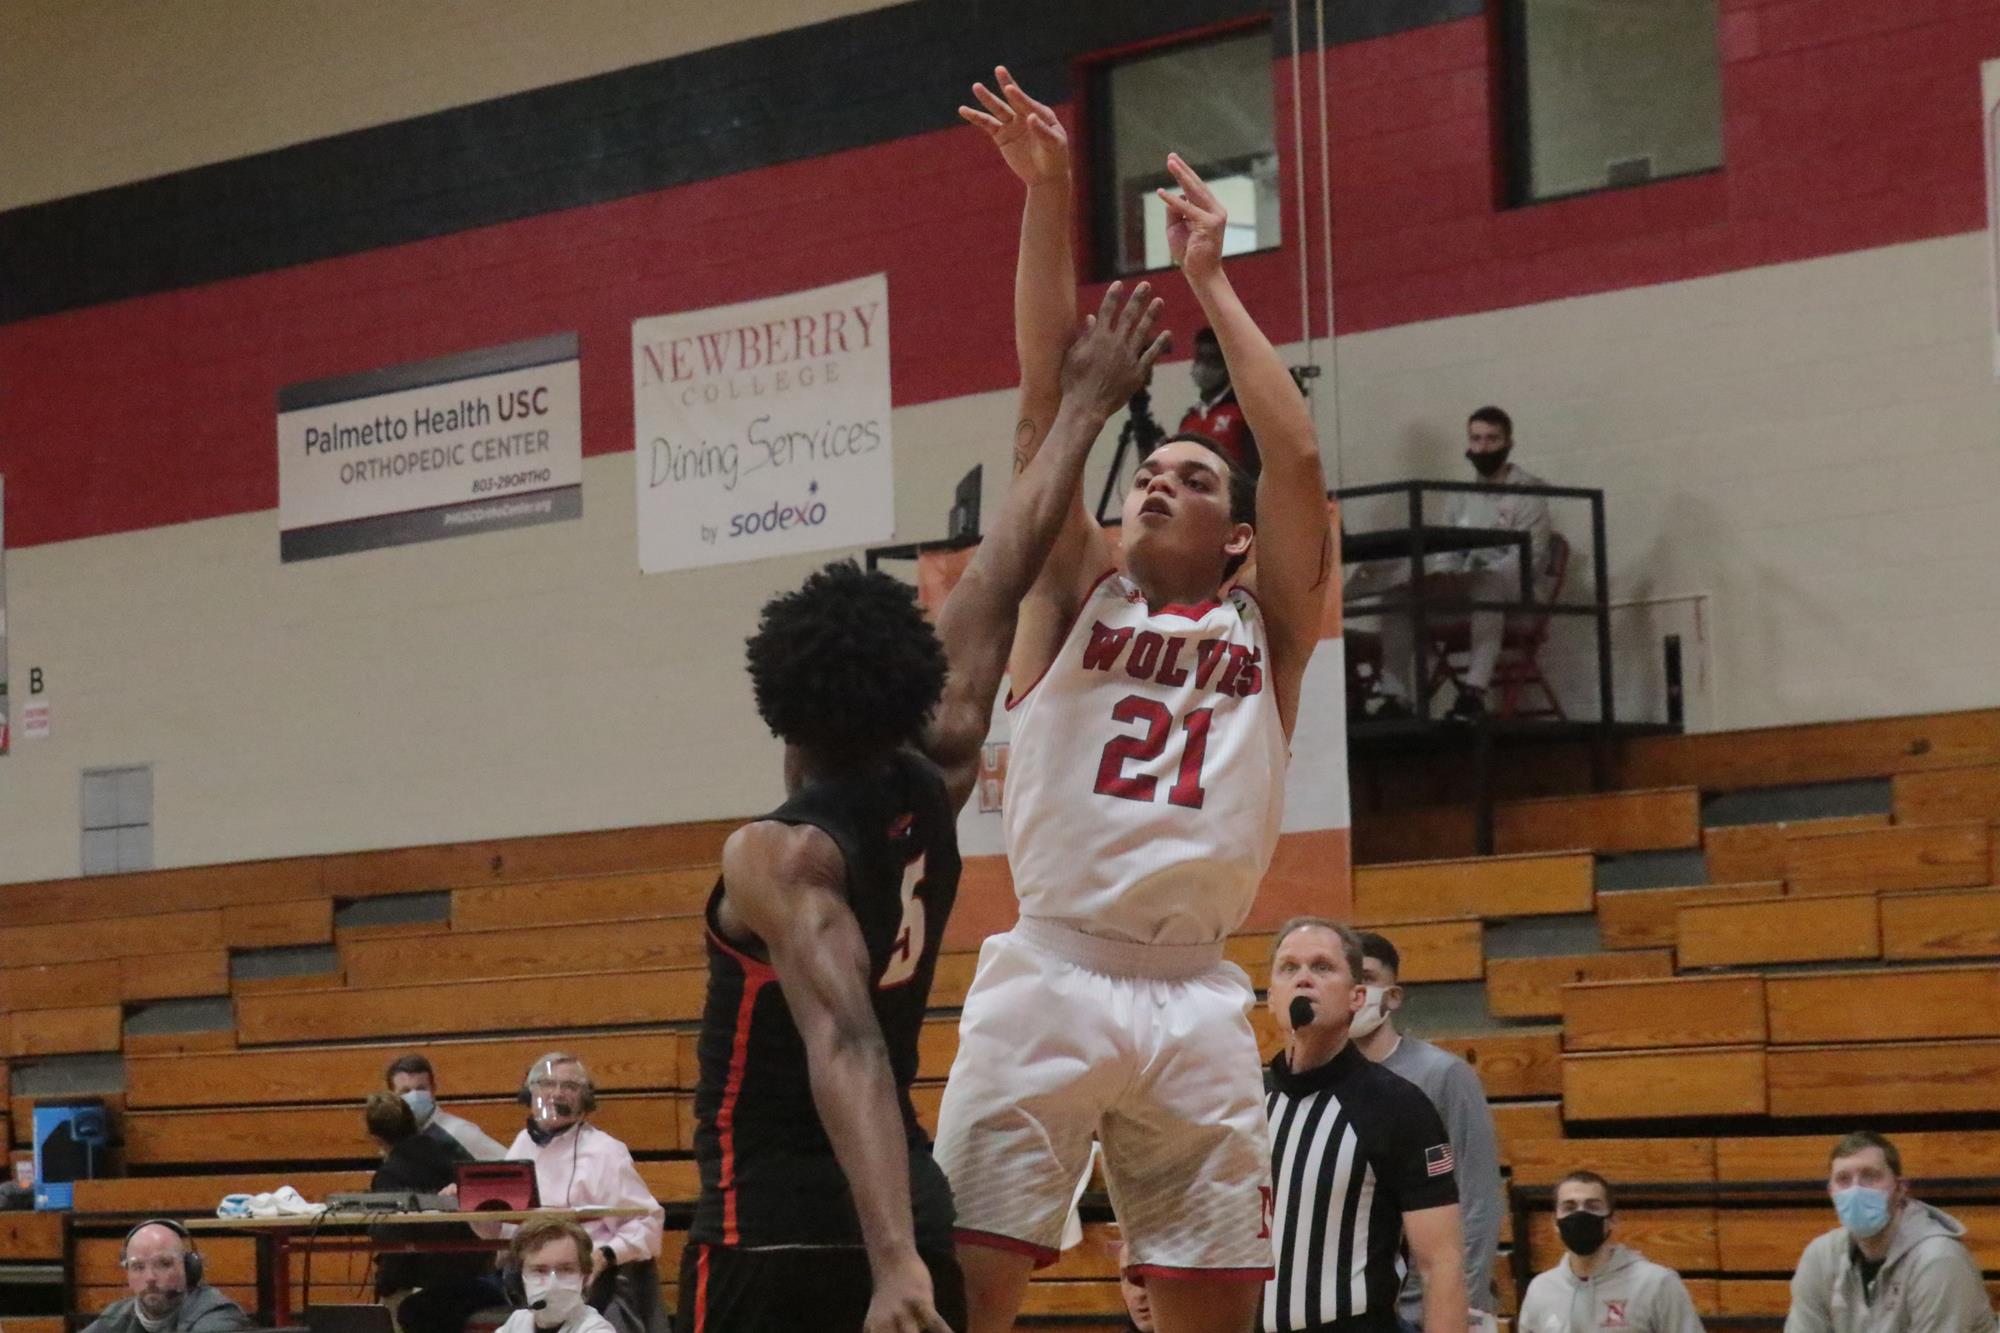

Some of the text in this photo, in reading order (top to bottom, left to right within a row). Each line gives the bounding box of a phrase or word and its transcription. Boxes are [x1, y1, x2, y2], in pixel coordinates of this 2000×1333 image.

[641, 303, 880, 388] NEWBERRY
[680, 362, 841, 406] COLLEGE
[305, 386, 549, 456] Palmetto Health USC
[340, 430, 550, 485] ORTHOPEDIC CENTER
[649, 414, 881, 491] Dining Services
[702, 501, 827, 544] by sodexo
[30, 667, 44, 694] B
[1092, 694, 1214, 810] 21
